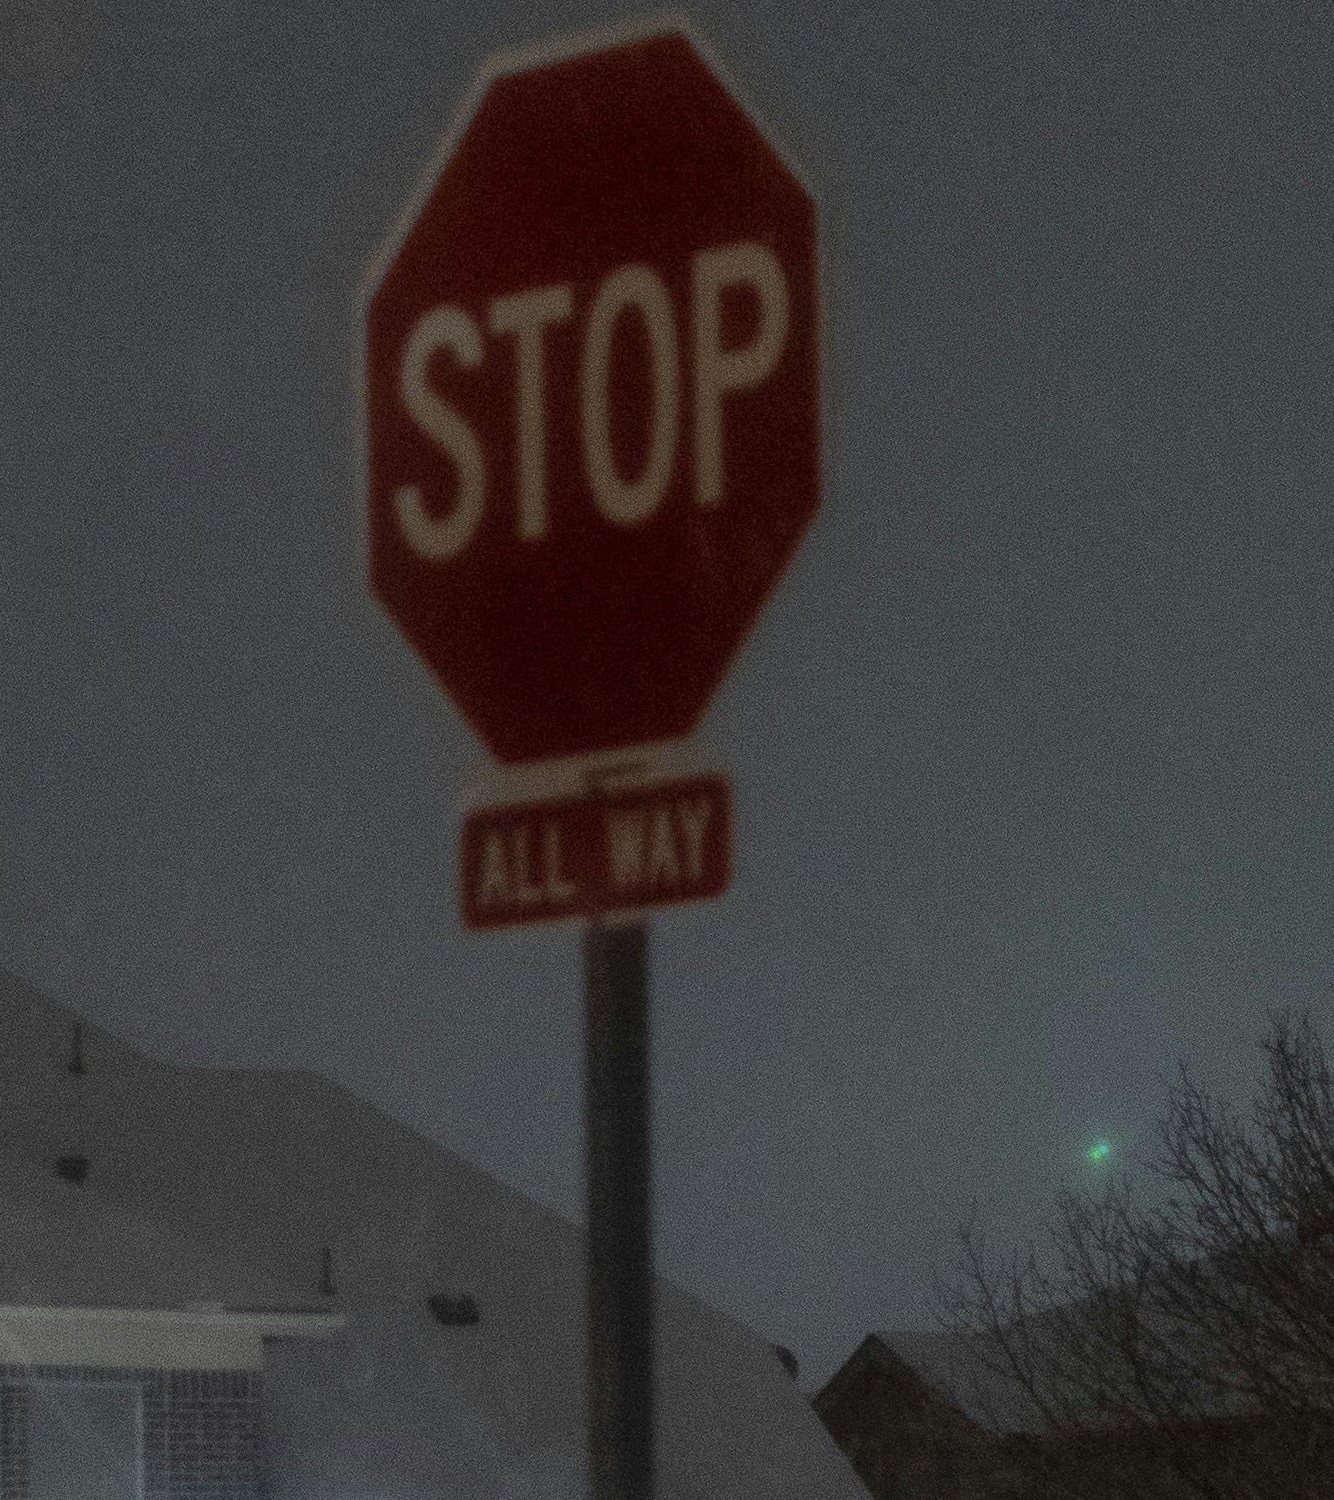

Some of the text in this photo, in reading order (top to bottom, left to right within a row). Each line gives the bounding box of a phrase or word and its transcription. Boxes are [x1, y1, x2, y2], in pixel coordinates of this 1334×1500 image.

[394, 243, 790, 561] STOP
[481, 795, 713, 903] ALL WAY
